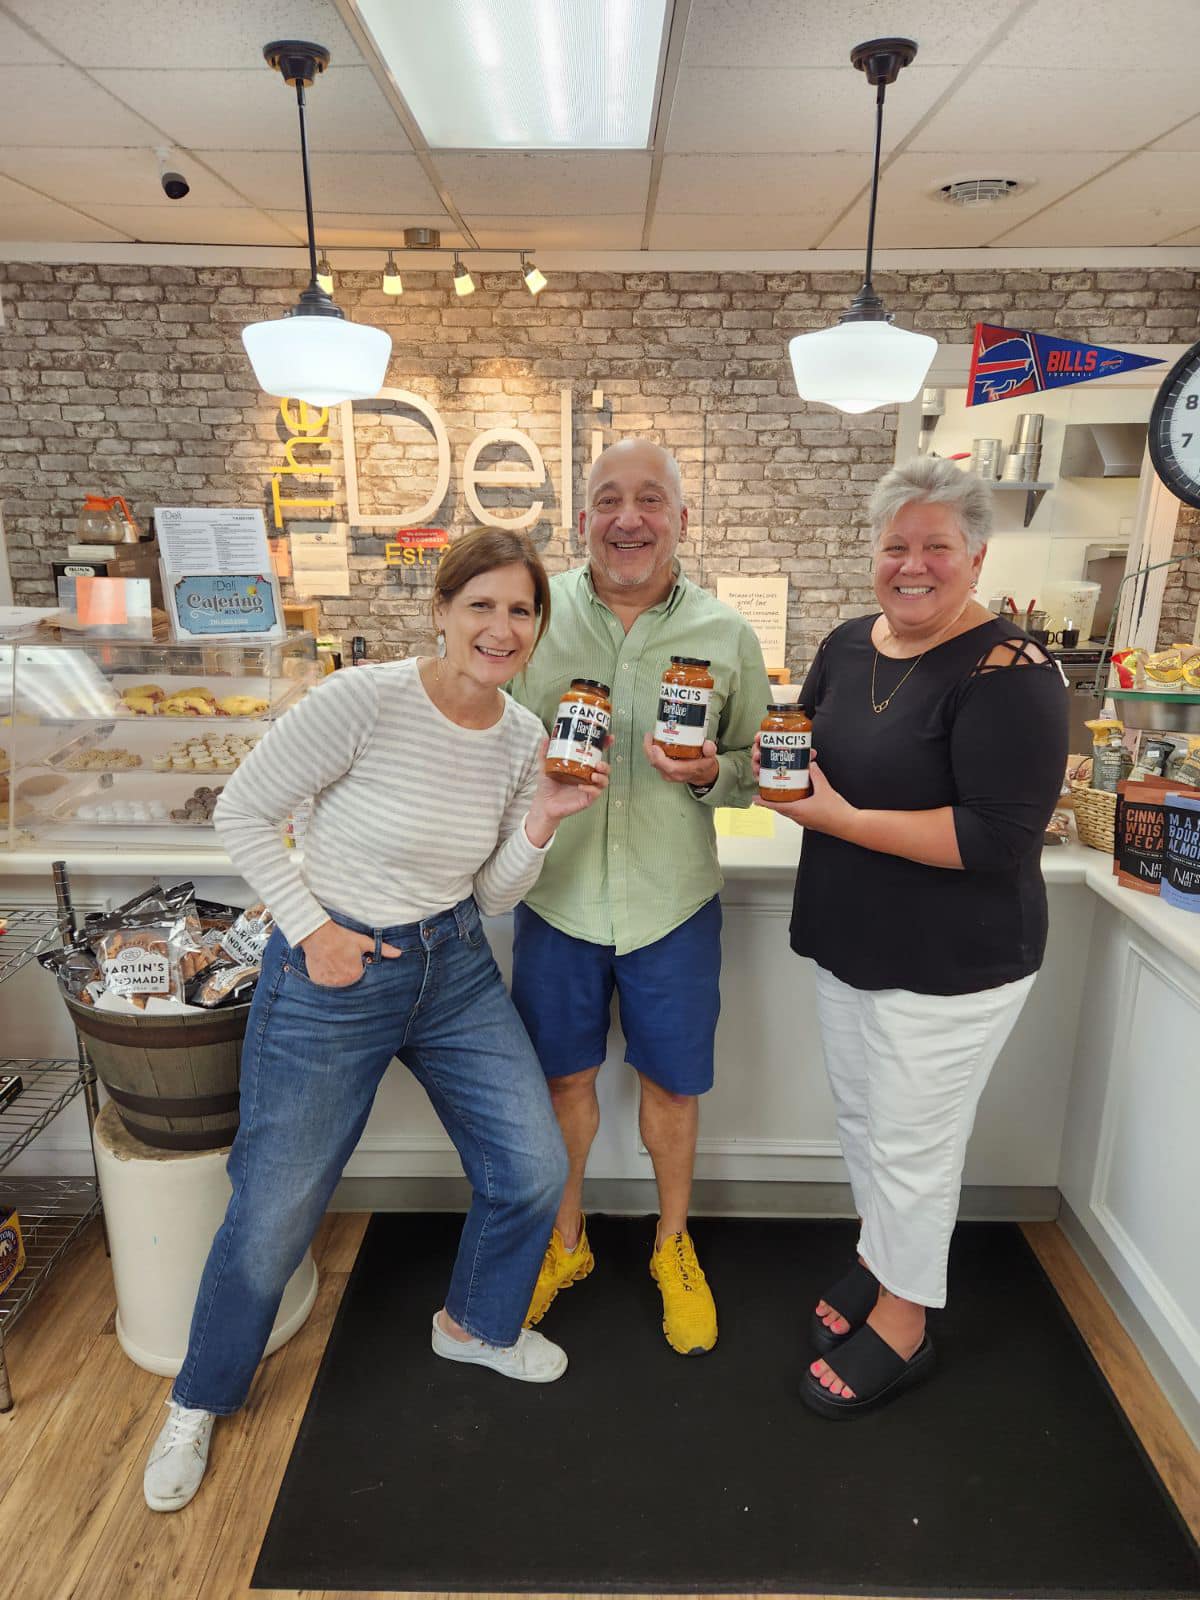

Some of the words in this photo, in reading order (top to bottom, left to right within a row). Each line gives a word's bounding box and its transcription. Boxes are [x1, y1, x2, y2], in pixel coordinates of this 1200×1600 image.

[1047, 350, 1098, 372] BILLS
[1186, 394, 1199, 410] 8
[1181, 432, 1194, 448] 7
[269, 396, 337, 529] The
[384, 542, 431, 566] Est.
[186, 592, 264, 613] Catering
[762, 734, 806, 745] GANCI'S
[1168, 825, 1200, 846] BOUR
[107, 975, 165, 986] DMADE
